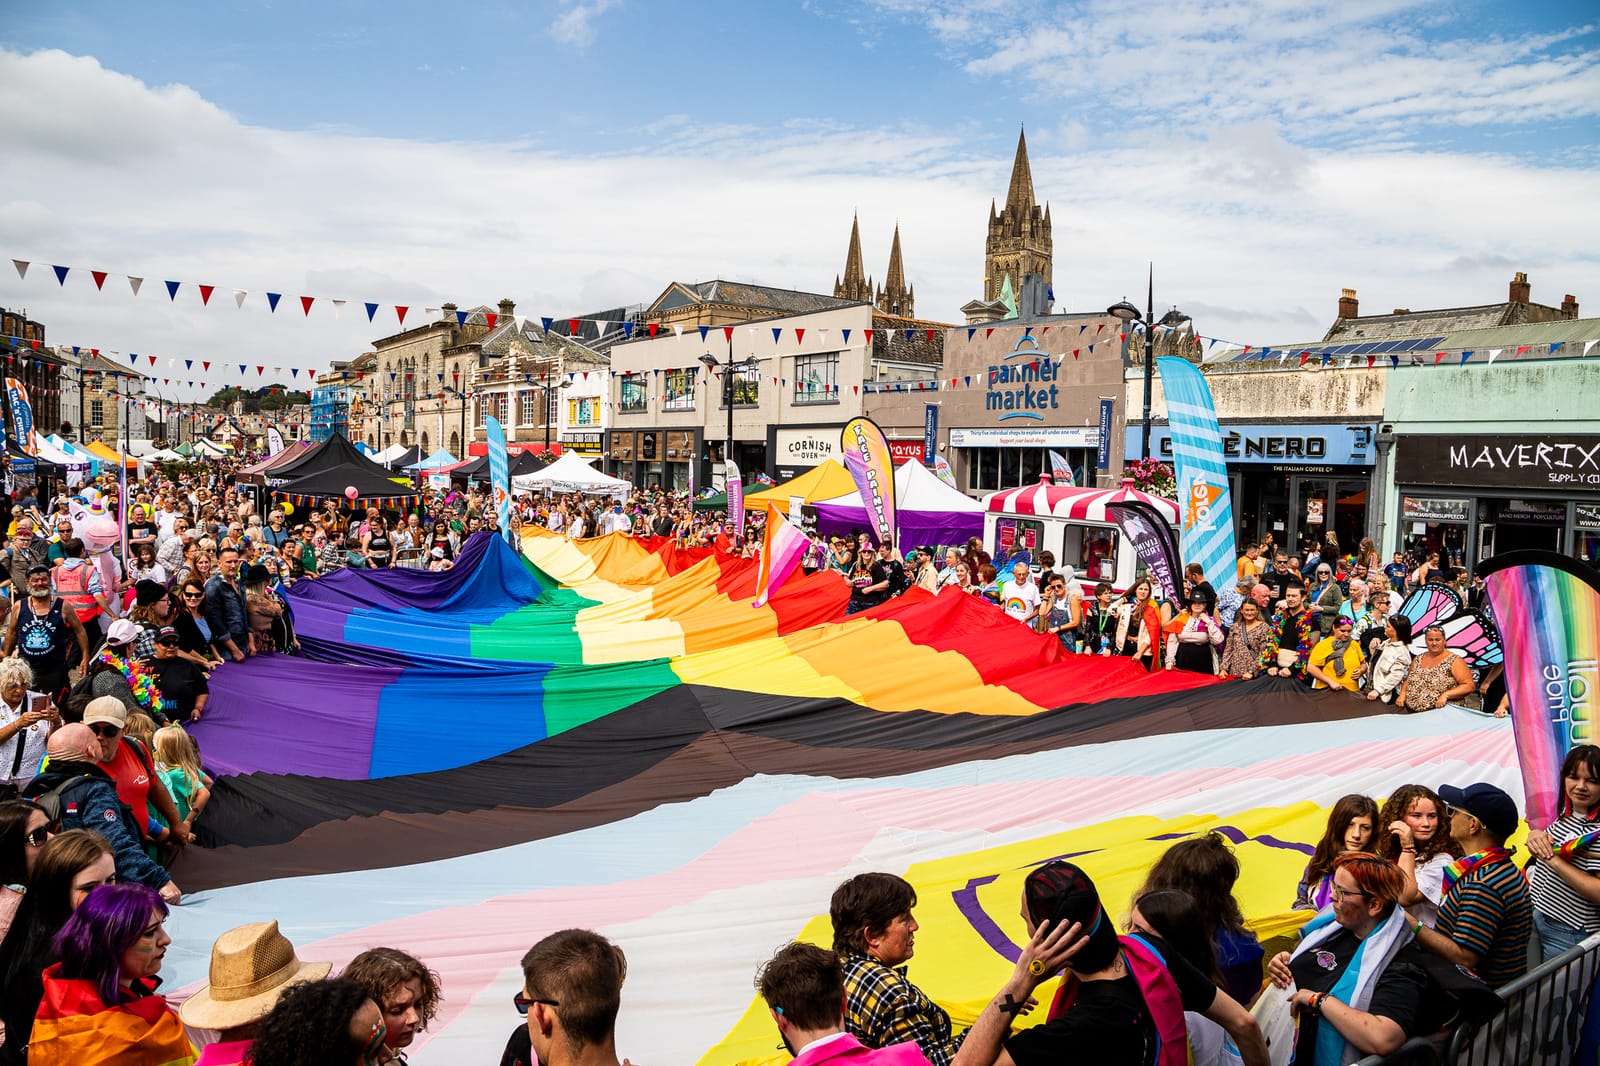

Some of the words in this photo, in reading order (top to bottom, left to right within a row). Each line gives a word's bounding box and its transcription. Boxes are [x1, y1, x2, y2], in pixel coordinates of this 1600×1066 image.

[987, 357, 1061, 389] pannier
[11, 390, 20, 406] MAC
[986, 383, 1059, 410] market
[15, 416, 27, 445] CHEESE
[788, 440, 832, 454] CORNISH
[801, 451, 818, 459] OVEN
[853, 424, 871, 463] FACE
[1245, 436, 1327, 458] NERO
[1450, 442, 1600, 471] MAVERIX
[1549, 473, 1585, 483] SUPPLY
